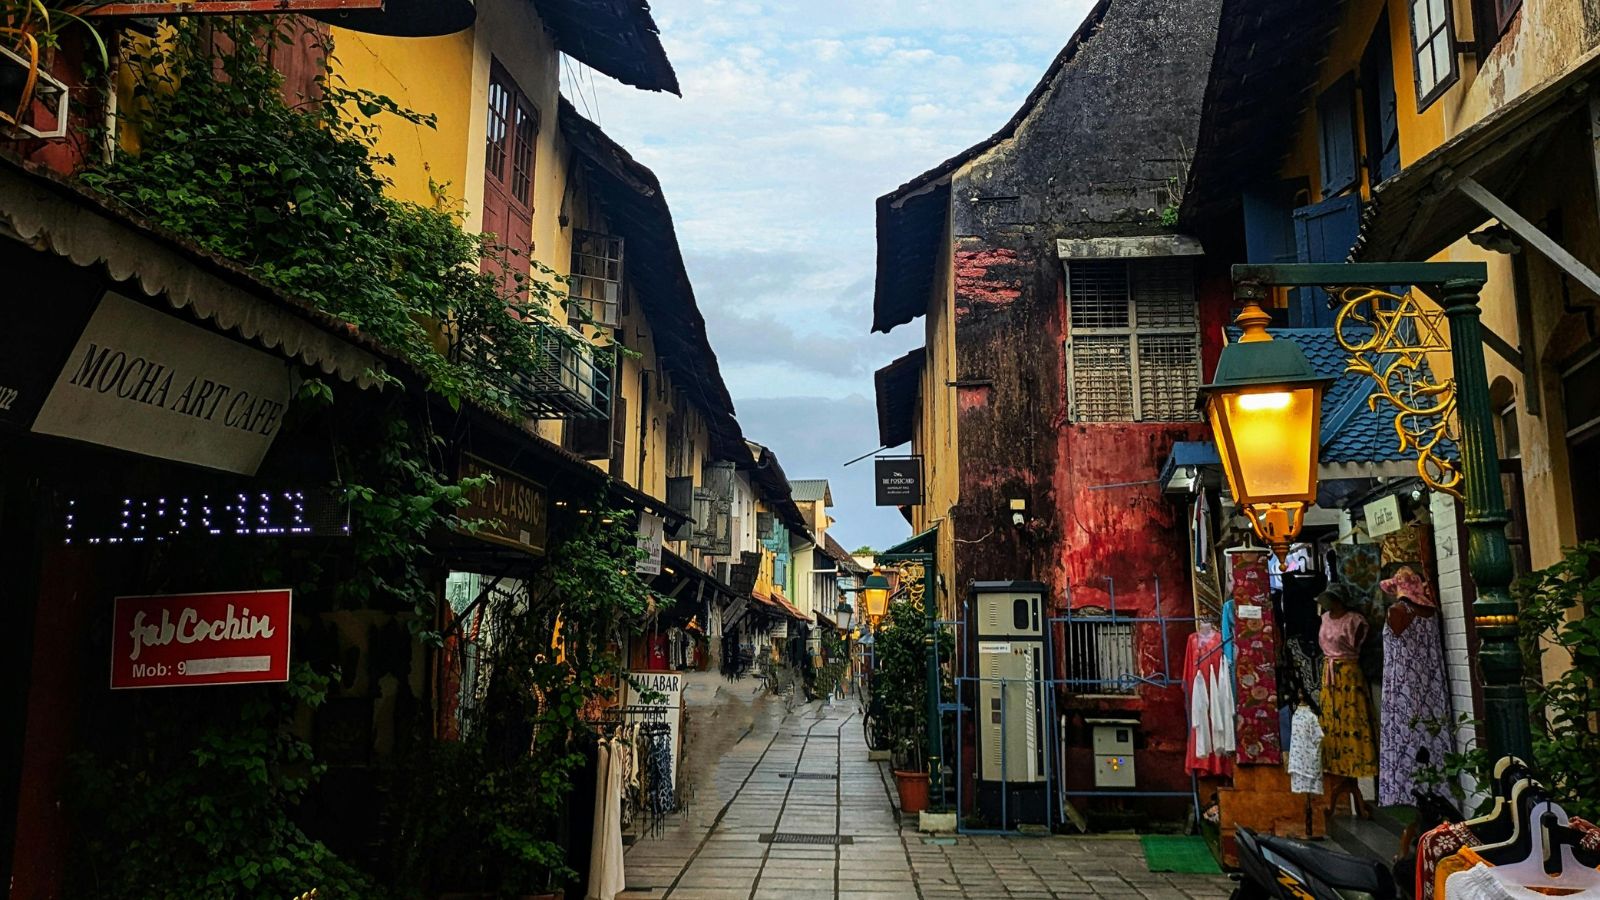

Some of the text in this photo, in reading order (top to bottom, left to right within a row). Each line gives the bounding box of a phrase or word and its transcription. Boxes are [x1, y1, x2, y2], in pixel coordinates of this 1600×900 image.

[69, 343, 284, 436] MOCHA ART CAFE
[494, 475, 540, 525] CLASSIC
[132, 662, 172, 678] Mob:
